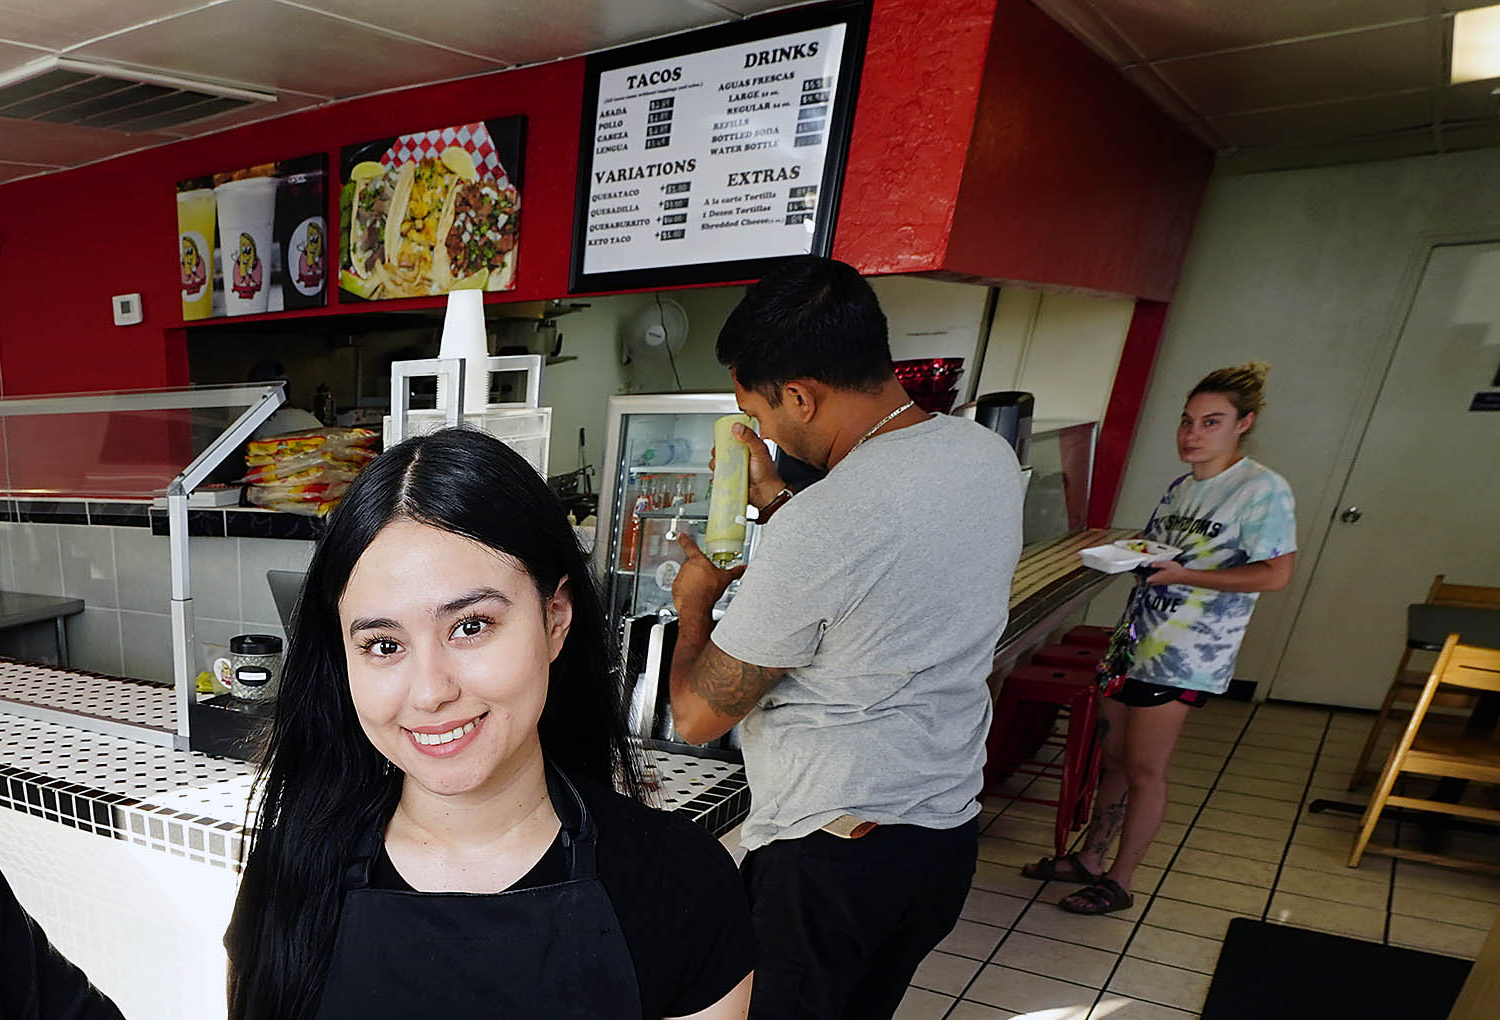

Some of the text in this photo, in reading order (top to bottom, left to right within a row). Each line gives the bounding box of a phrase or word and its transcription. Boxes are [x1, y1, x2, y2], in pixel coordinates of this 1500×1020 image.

[744, 41, 819, 69] DRINKS
[627, 67, 682, 90] TACOS
[718, 71, 796, 92] AGUAS FRESCAS
[729, 90, 760, 103] LARGE
[600, 107, 628, 118] ASADA
[727, 102, 771, 116] REGULAR
[598, 120, 624, 131] POLLO
[713, 118, 750, 130] REFILLS
[597, 131, 629, 143] CABEZA
[711, 127, 779, 143] BOTTLED SODA
[596, 143, 628, 155] LENGUA
[710, 144, 742, 156] WATER
[595, 158, 697, 184] VARIATIONS
[727, 165, 801, 187] EXTRAS
[592, 189, 640, 203] QUESATACO
[745, 191, 777, 202] Tortilla
[590, 205, 639, 218] QUESADILLA
[736, 205, 771, 215] Tortillas
[701, 219, 739, 231] Shredded
[587, 238, 609, 247] KETO
[610, 235, 631, 245] TACO
